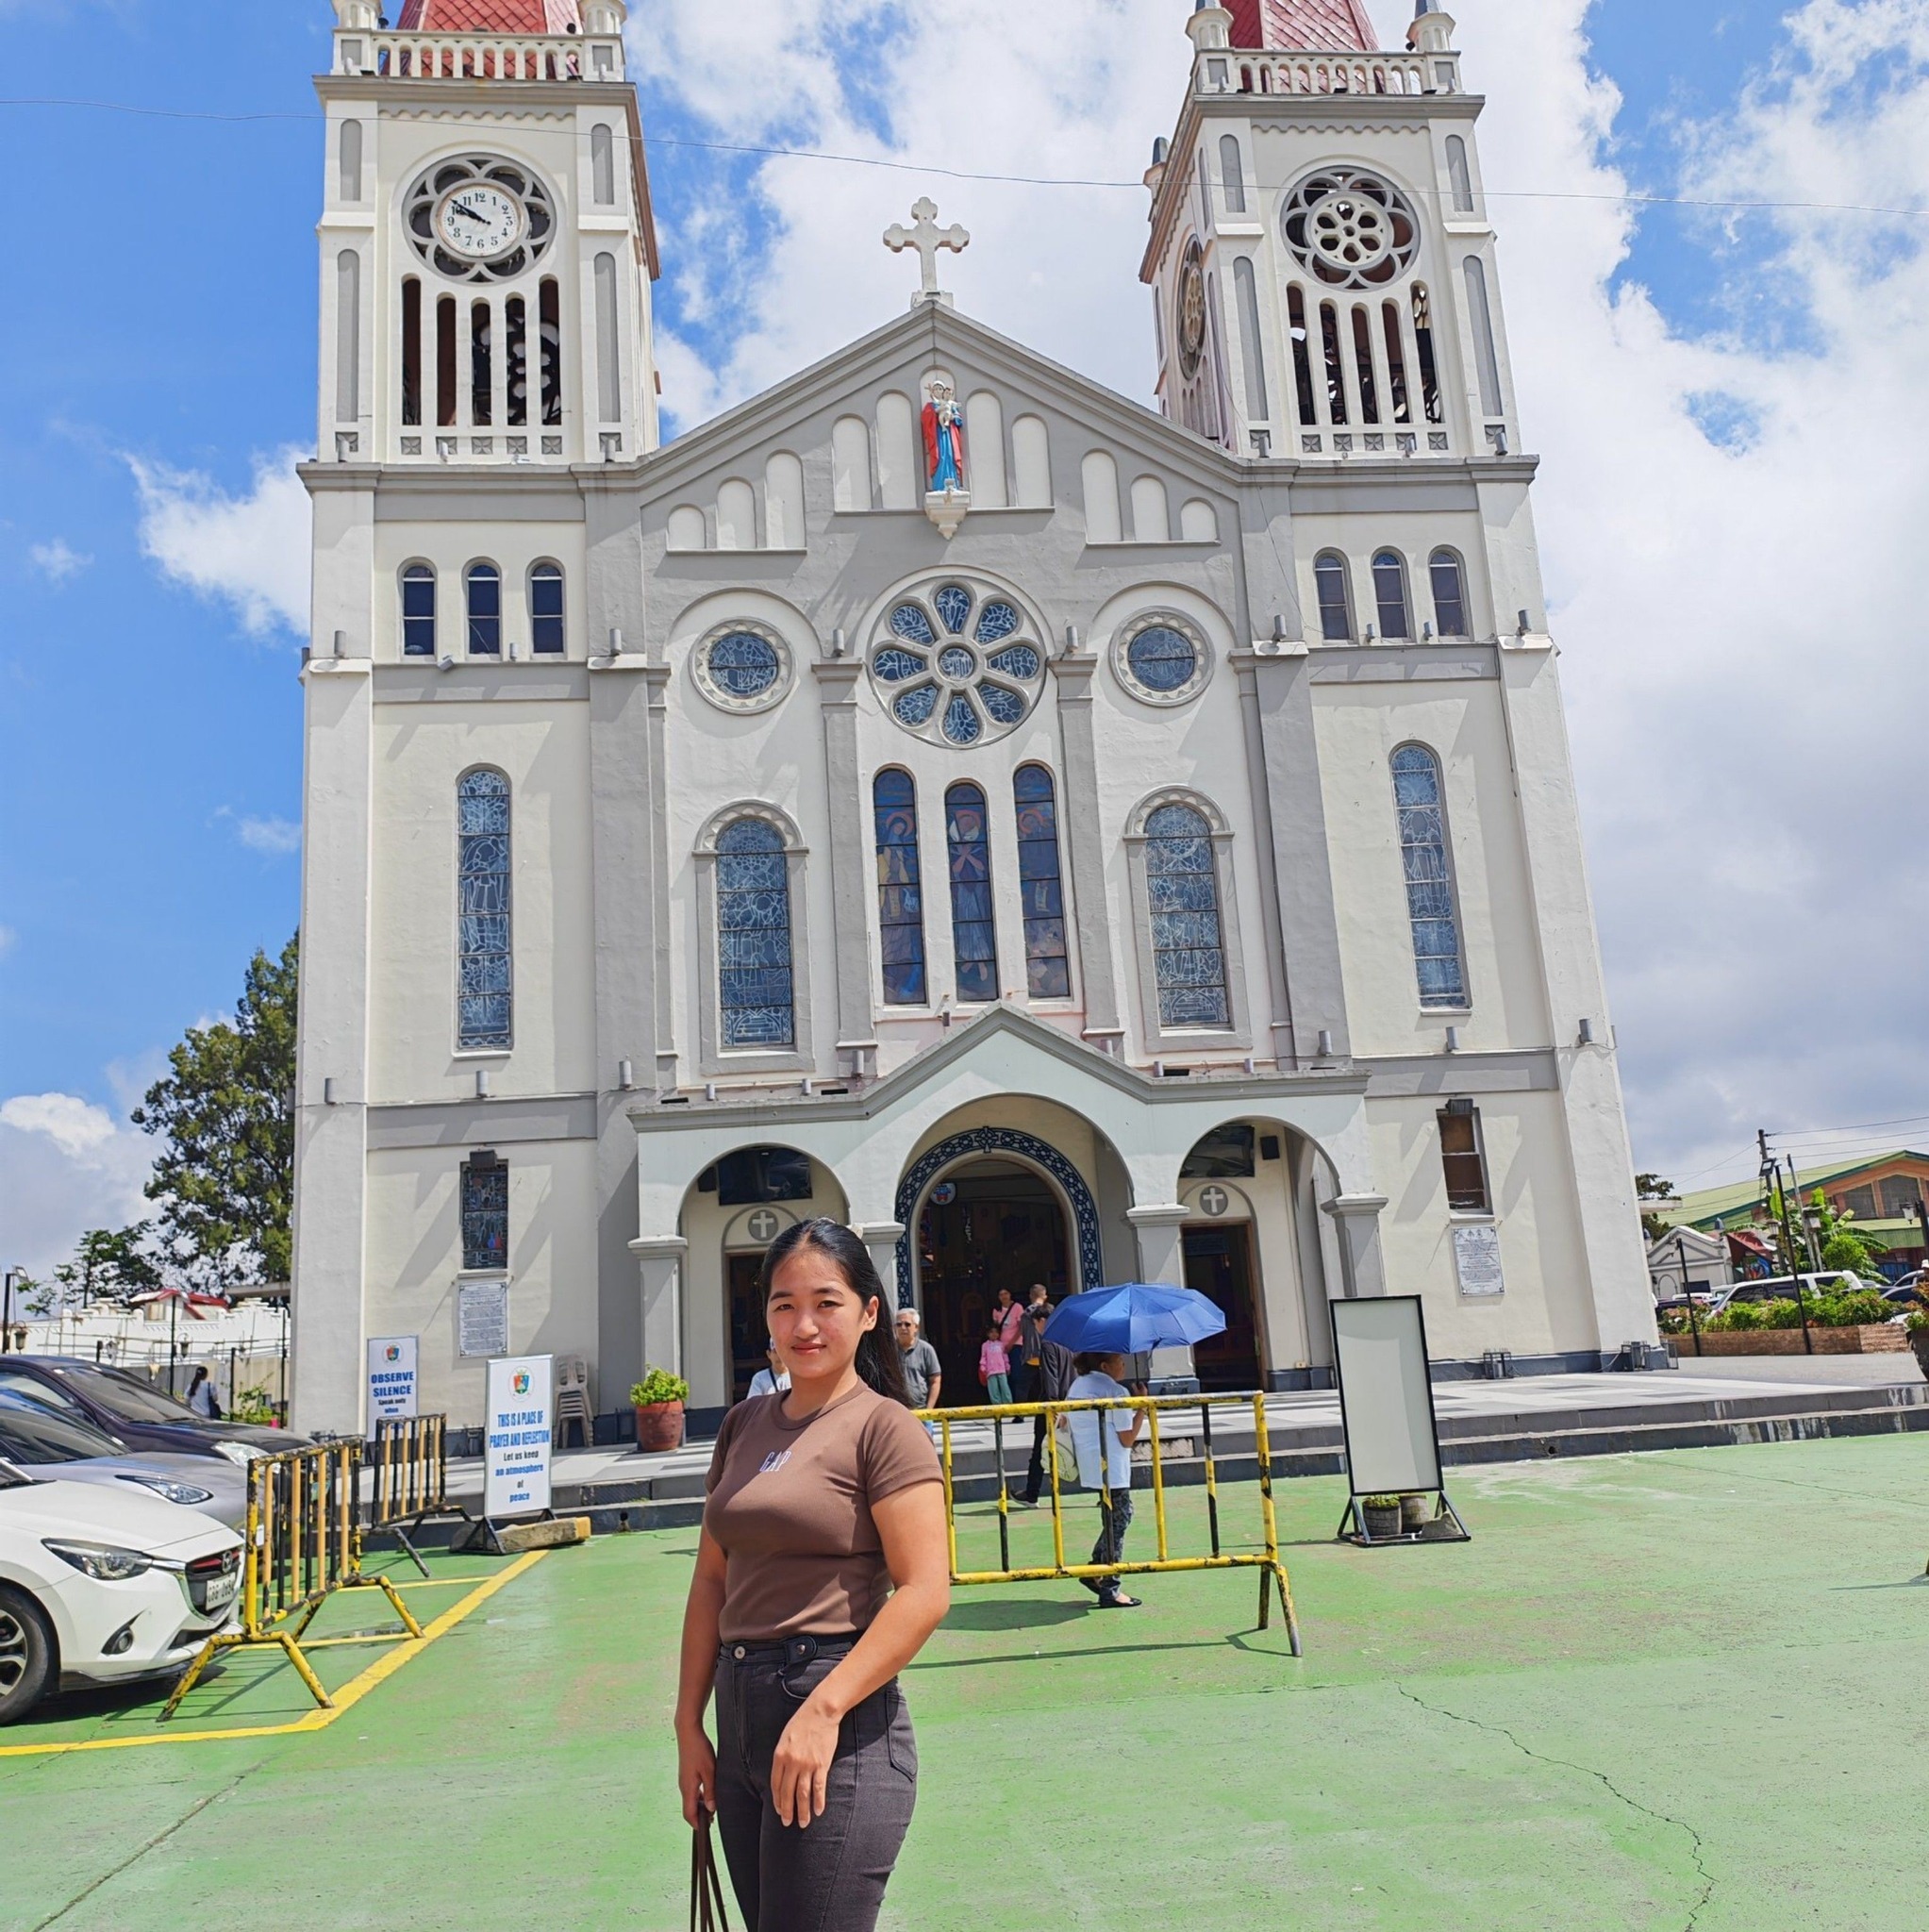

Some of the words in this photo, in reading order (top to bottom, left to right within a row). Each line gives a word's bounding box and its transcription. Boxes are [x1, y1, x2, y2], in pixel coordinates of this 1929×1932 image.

[463, 196, 472, 207] 11
[474, 192, 486, 203] 12
[492, 196, 497, 207] 1
[502, 204, 509, 215] 2
[447, 216, 455, 226] 9
[506, 216, 513, 226] 3
[453, 227, 461, 238] 8
[501, 227, 508, 238] 4
[465, 236, 472, 246] 7
[476, 239, 485, 249] 6
[491, 236, 498, 246] 5
[371, 1371, 414, 1384] OBSERVE
[373, 1385, 412, 1397] SILENCE
[498, 1413, 510, 1427] THIS
[510, 1412, 516, 1426] IS
[521, 1411, 536, 1425] PLACE
[537, 1410, 543, 1424] OF
[490, 1434, 508, 1448] PRAYER
[510, 1433, 521, 1446] AND
[522, 1430, 549, 1445] REFLECTION
[504, 1453, 513, 1461] Let
[524, 1450, 540, 1459] keep
[759, 1451, 792, 1472] GAP
[495, 1468, 505, 1476] an
[506, 1464, 543, 1475] atmosphere
[517, 1479, 524, 1489] of
[509, 1492, 530, 1503] peace
